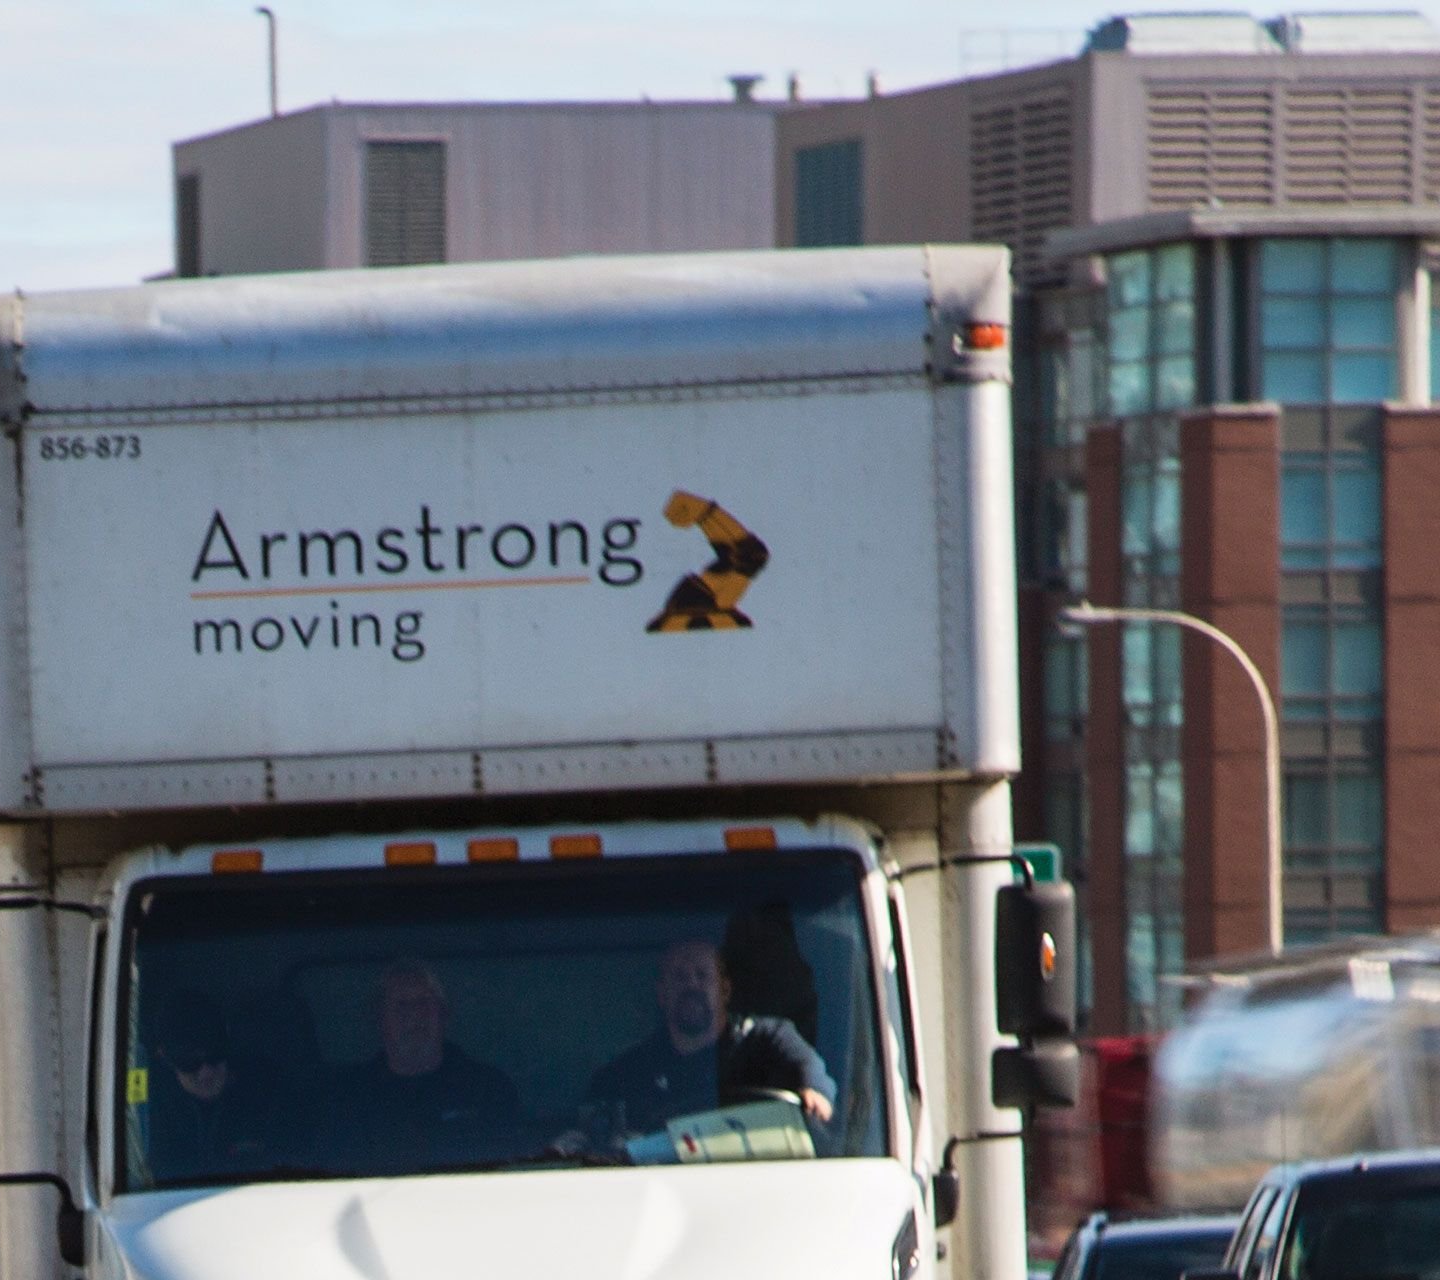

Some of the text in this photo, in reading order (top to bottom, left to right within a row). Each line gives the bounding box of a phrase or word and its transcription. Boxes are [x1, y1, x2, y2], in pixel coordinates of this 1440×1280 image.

[40, 434, 141, 461] 856-873
[191, 504, 645, 587] Armstrong
[193, 600, 426, 663] moving
